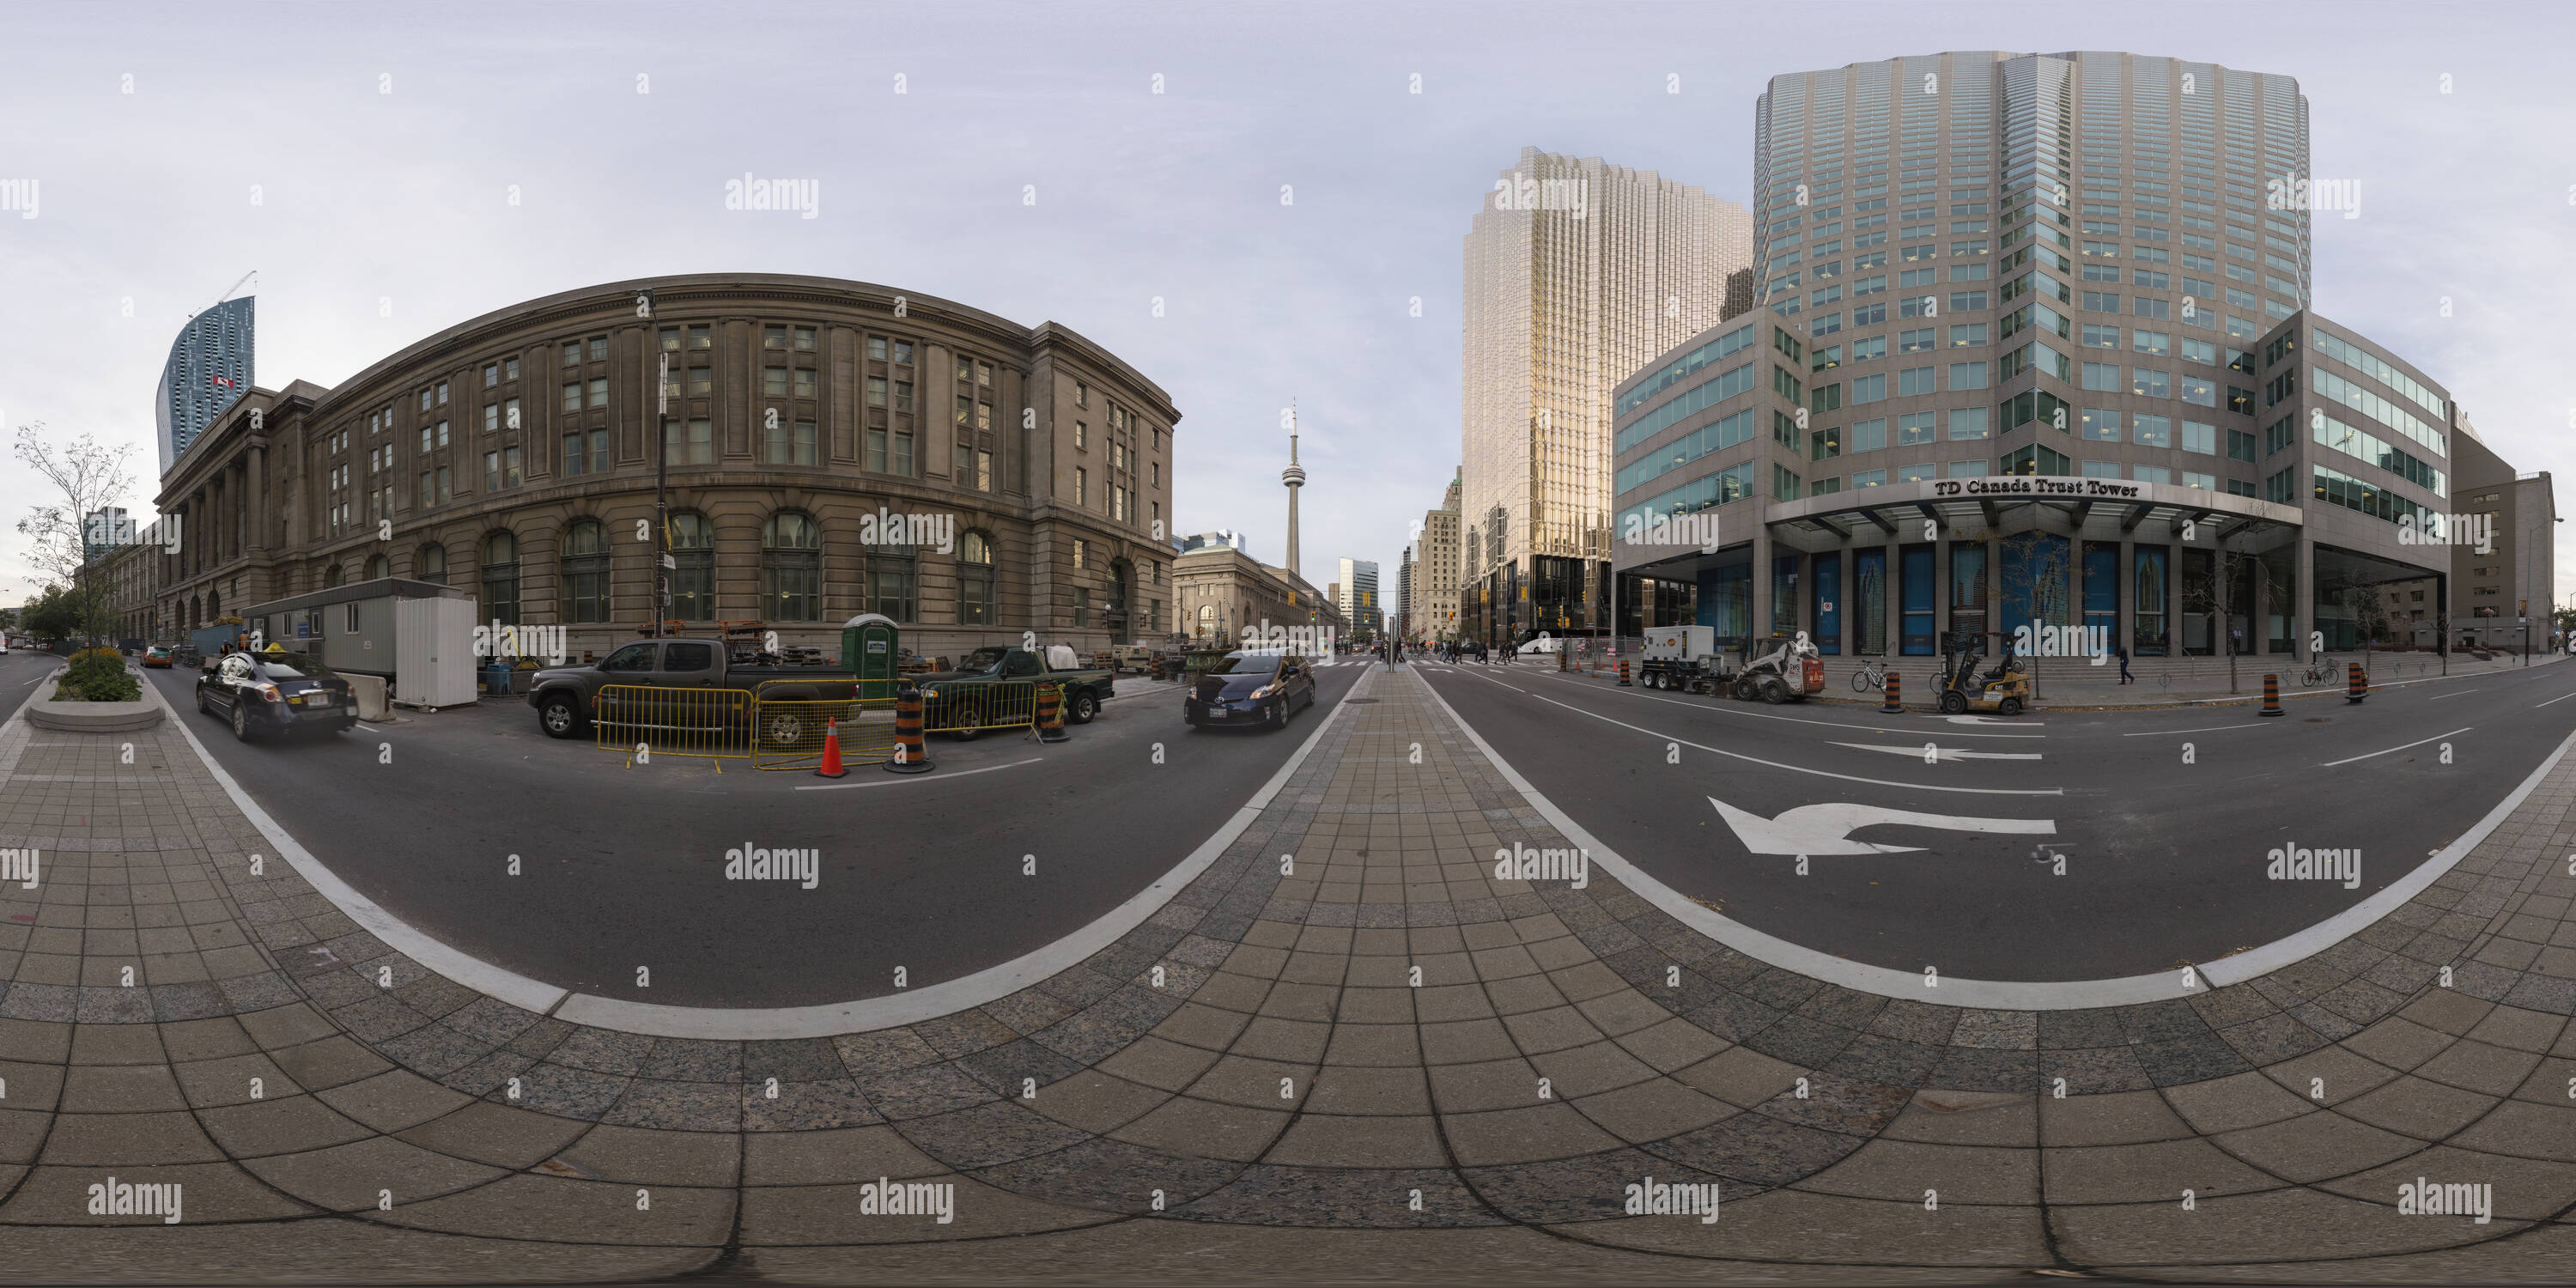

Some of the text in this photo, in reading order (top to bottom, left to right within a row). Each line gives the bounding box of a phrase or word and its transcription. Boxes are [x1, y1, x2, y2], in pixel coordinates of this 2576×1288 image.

[1935, 477, 2139, 497] TD Canada Trust Tower
